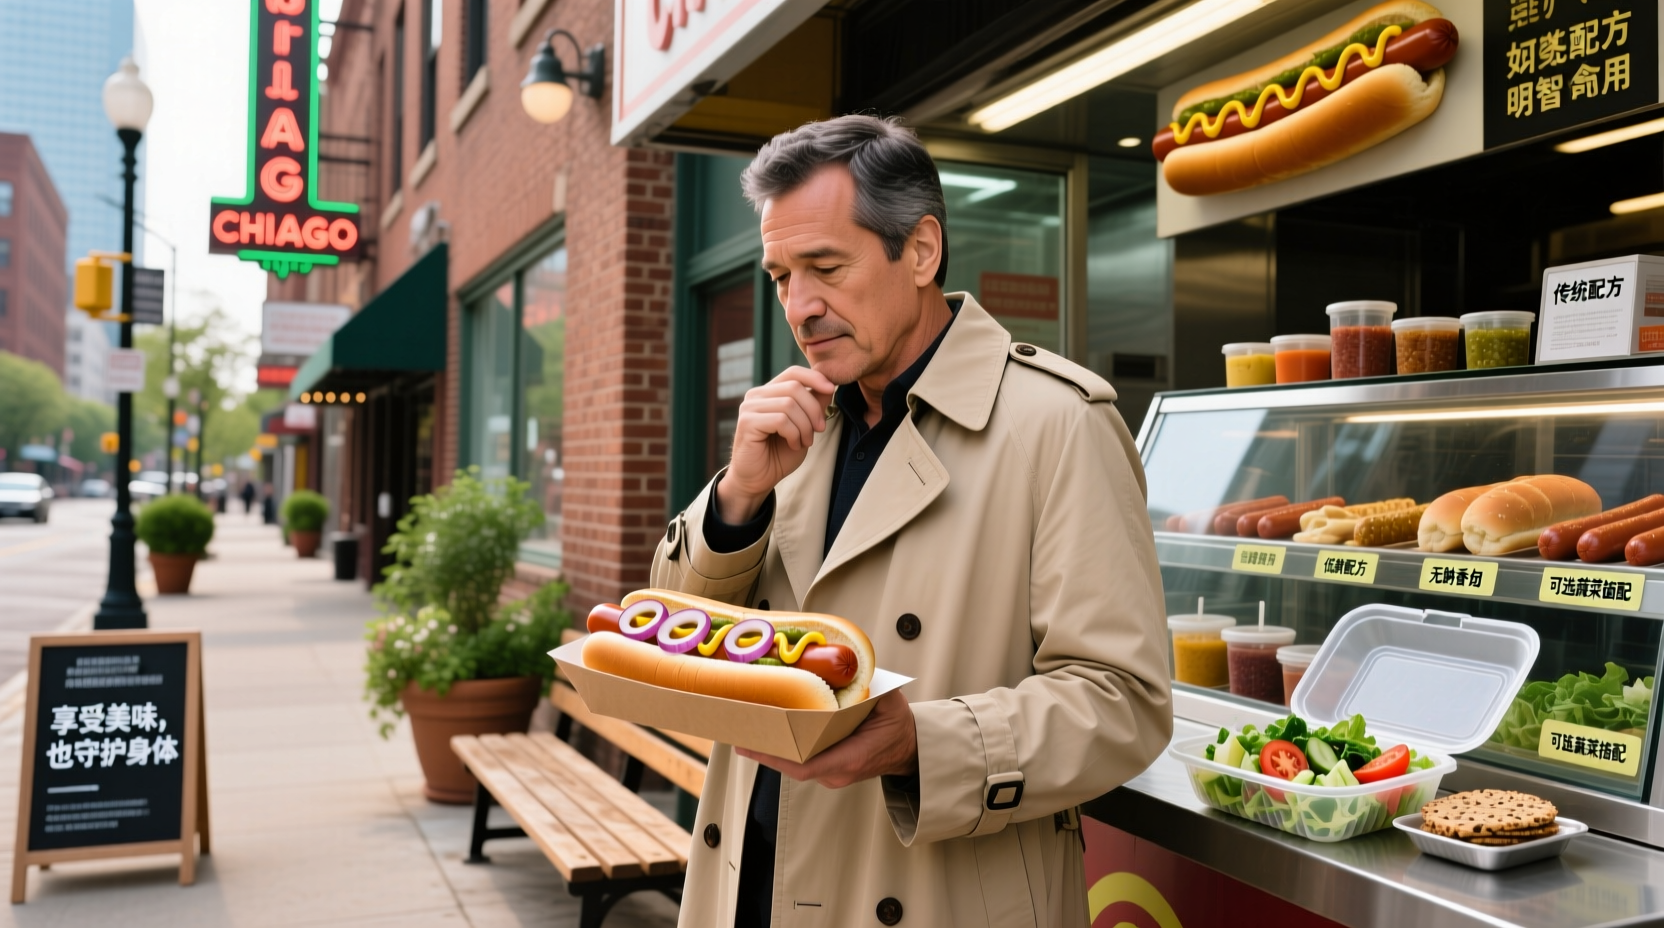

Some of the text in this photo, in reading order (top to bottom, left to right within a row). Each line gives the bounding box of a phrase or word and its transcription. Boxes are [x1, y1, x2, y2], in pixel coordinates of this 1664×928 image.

[212, 210, 358, 251] CHIAGO
[1553, 275, 1625, 305] 传统配方
[46, 734, 179, 770] 也守护身体
